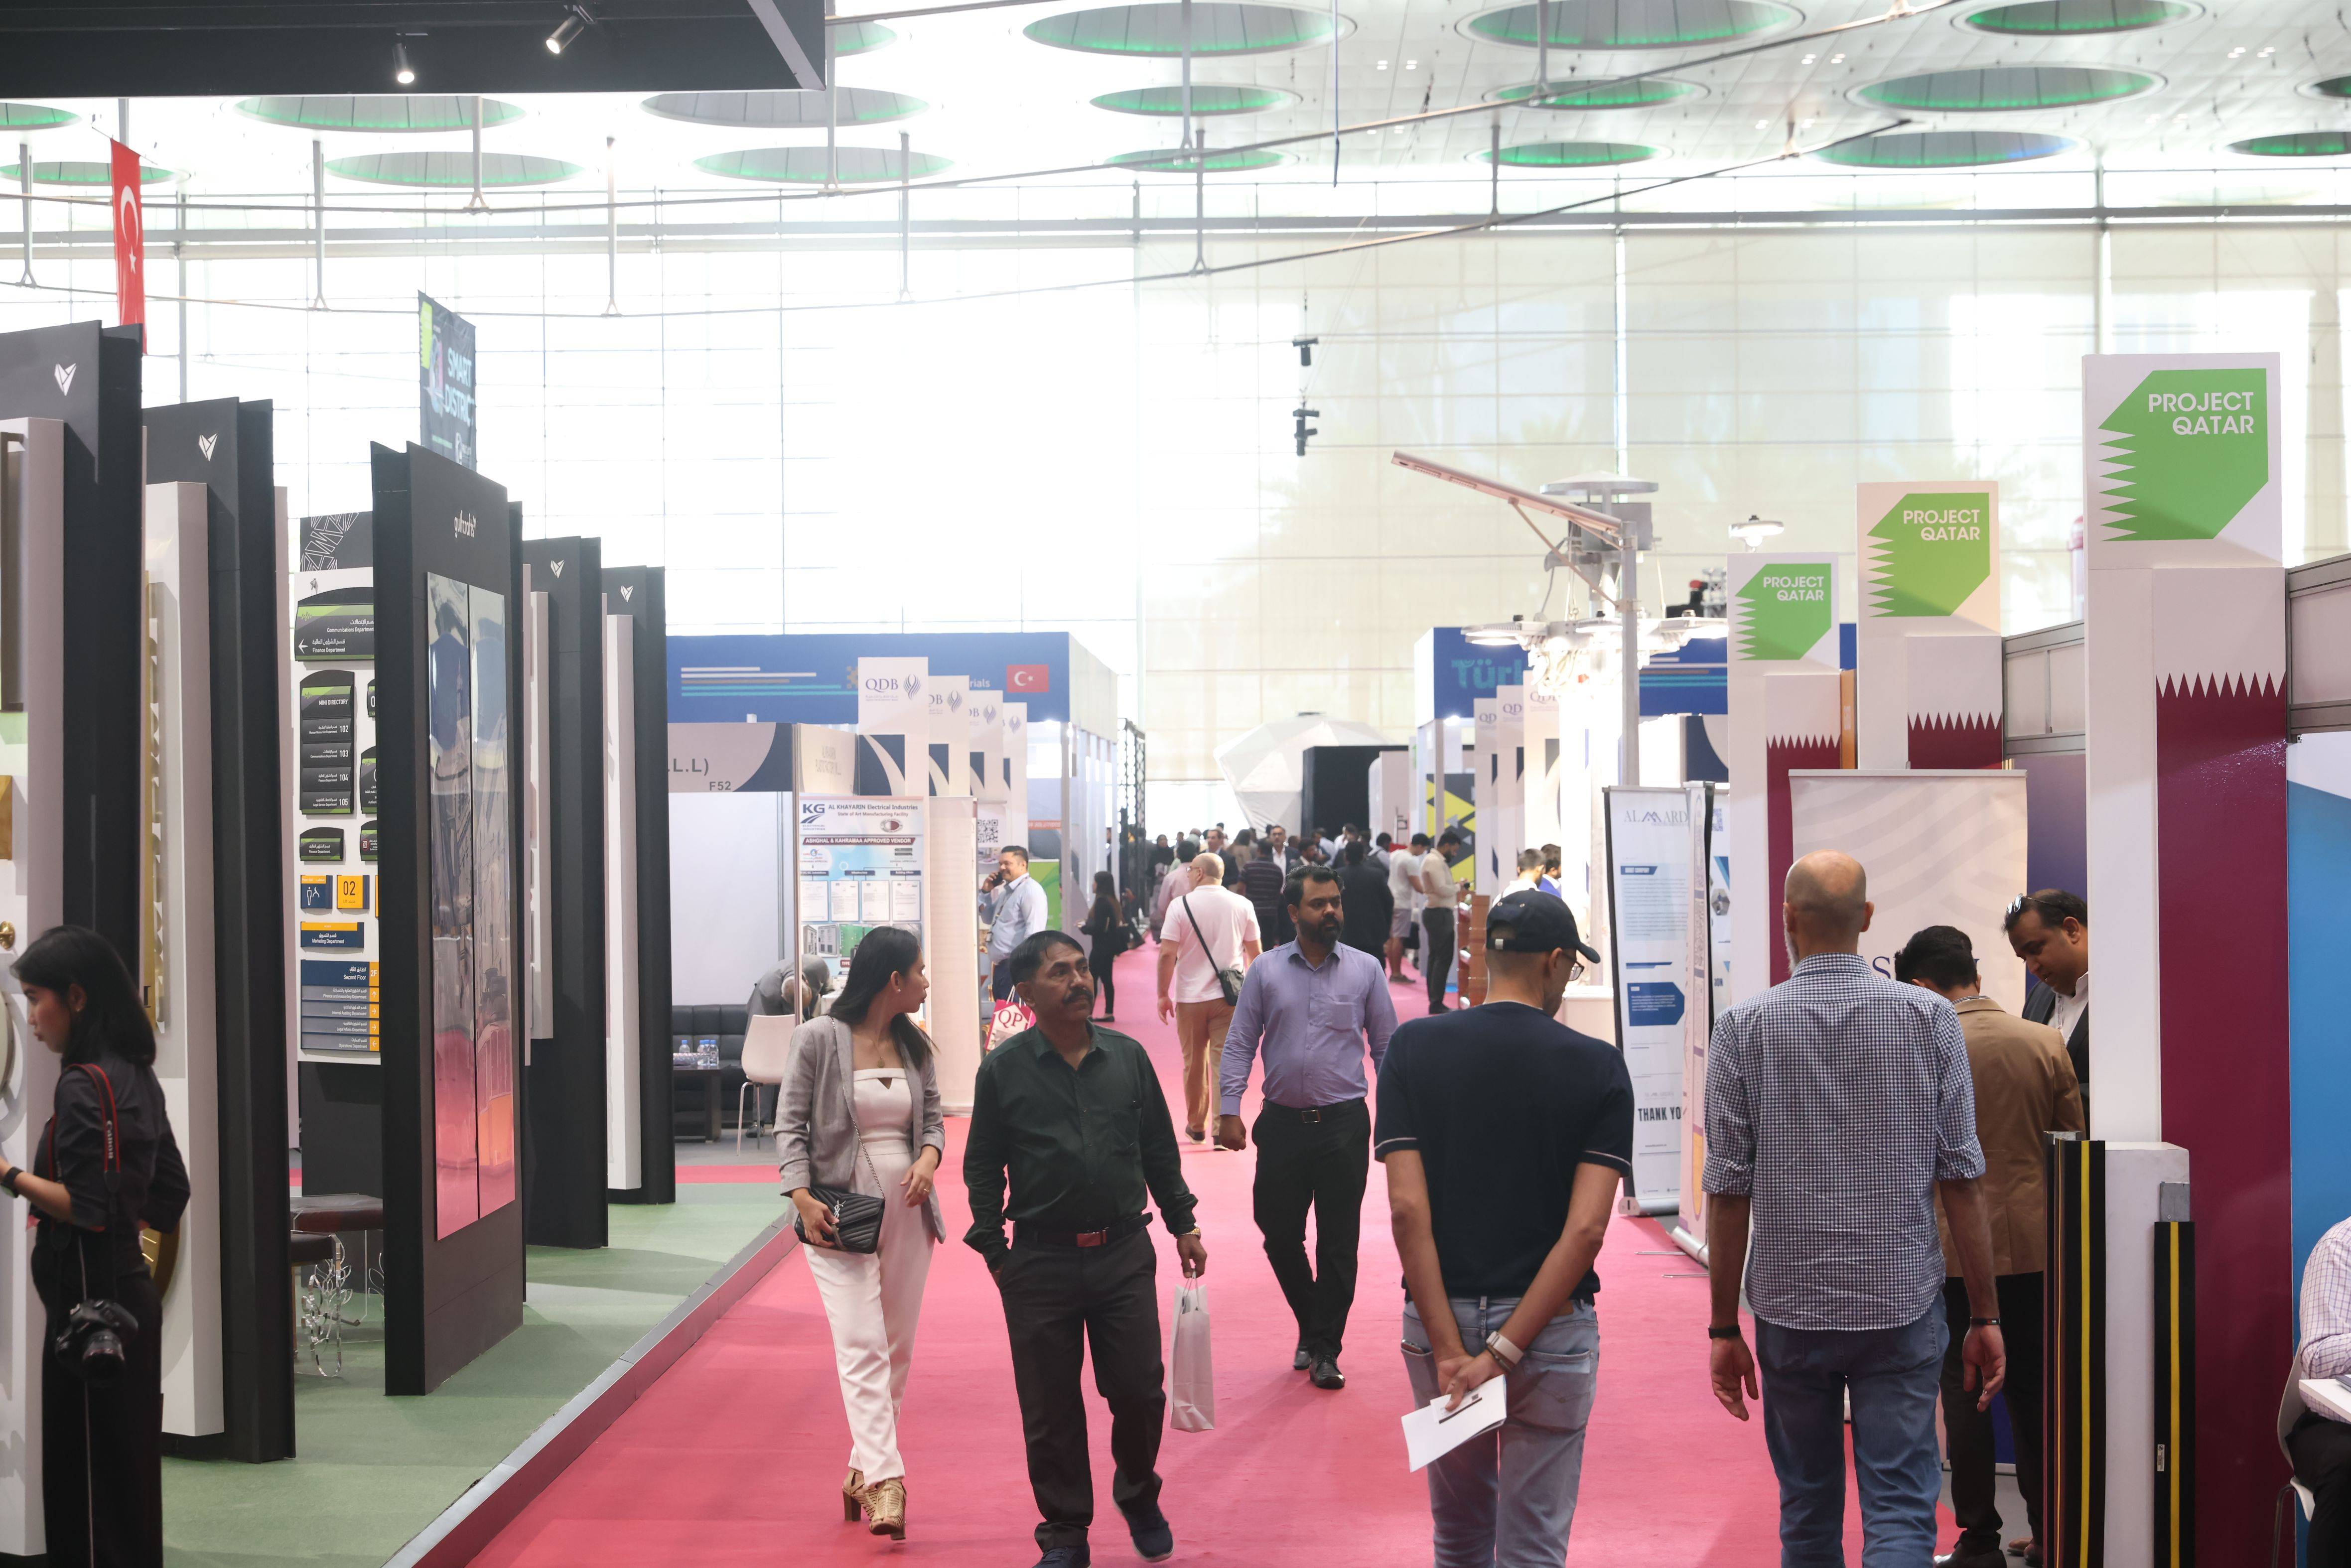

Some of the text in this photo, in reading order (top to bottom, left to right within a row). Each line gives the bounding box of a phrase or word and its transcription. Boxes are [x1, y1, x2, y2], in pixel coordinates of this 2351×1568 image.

[448, 347, 471, 388] SMART
[2149, 392, 2254, 412] PROJECT
[2173, 415, 2254, 435] QATAR
[1904, 510, 1980, 523] PROJECT
[454, 510, 474, 538] gulfcrafts
[1921, 526, 1980, 540] QATAR
[1764, 576, 1824, 587] PROJECT
[1777, 590, 1823, 601] QATAR
[865, 678, 898, 693] QDB
[970, 679, 990, 688] rials
[929, 694, 943, 705] DB
[1503, 704, 1522, 715] QD
[1479, 713, 1497, 724] QD
[668, 758, 708, 776] .L.L)
[709, 781, 731, 791] F52
[803, 804, 825, 813] KG
[344, 881, 355, 896] 02
[998, 1010, 1023, 1028] QP
[1638, 1106, 1681, 1121] THANK YO
